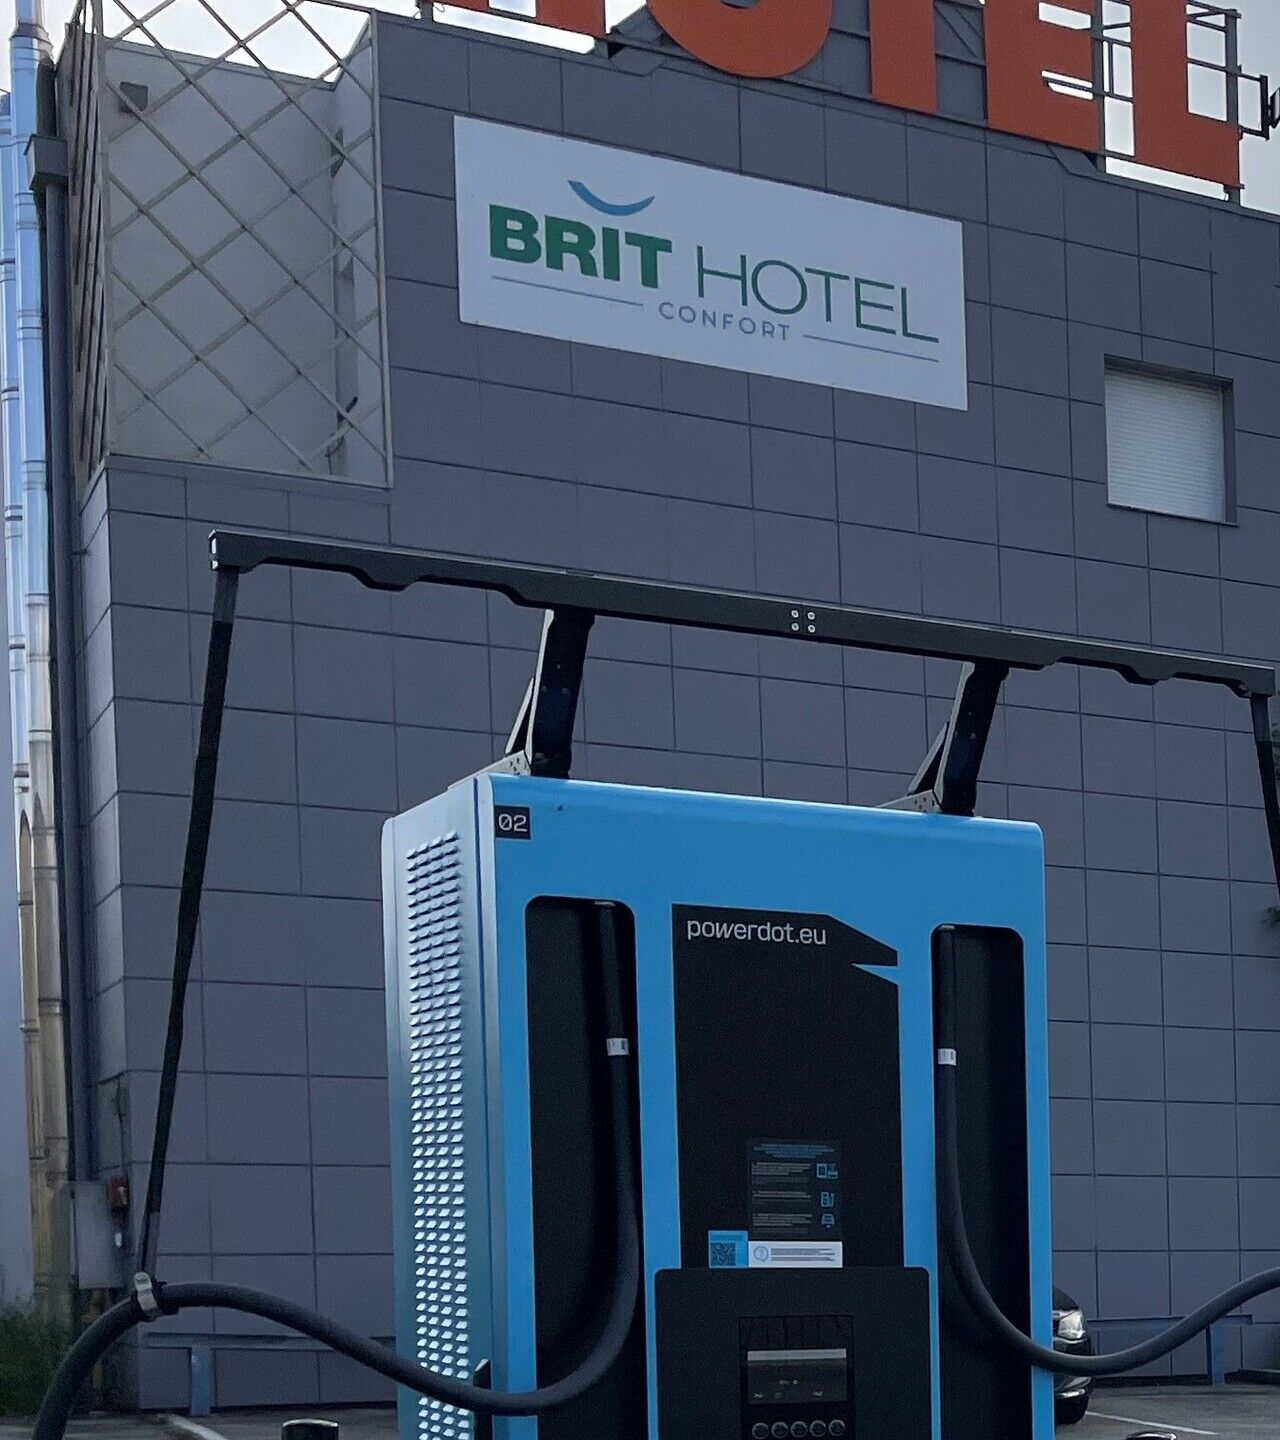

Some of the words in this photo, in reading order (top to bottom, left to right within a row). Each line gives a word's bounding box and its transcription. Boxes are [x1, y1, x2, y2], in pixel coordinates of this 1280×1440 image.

[488, 204, 673, 289] BRIT
[696, 245, 940, 343] HOTEL
[658, 301, 791, 341] CONFORT
[499, 813, 528, 832] 02
[687, 919, 827, 945] powerdot.eu
